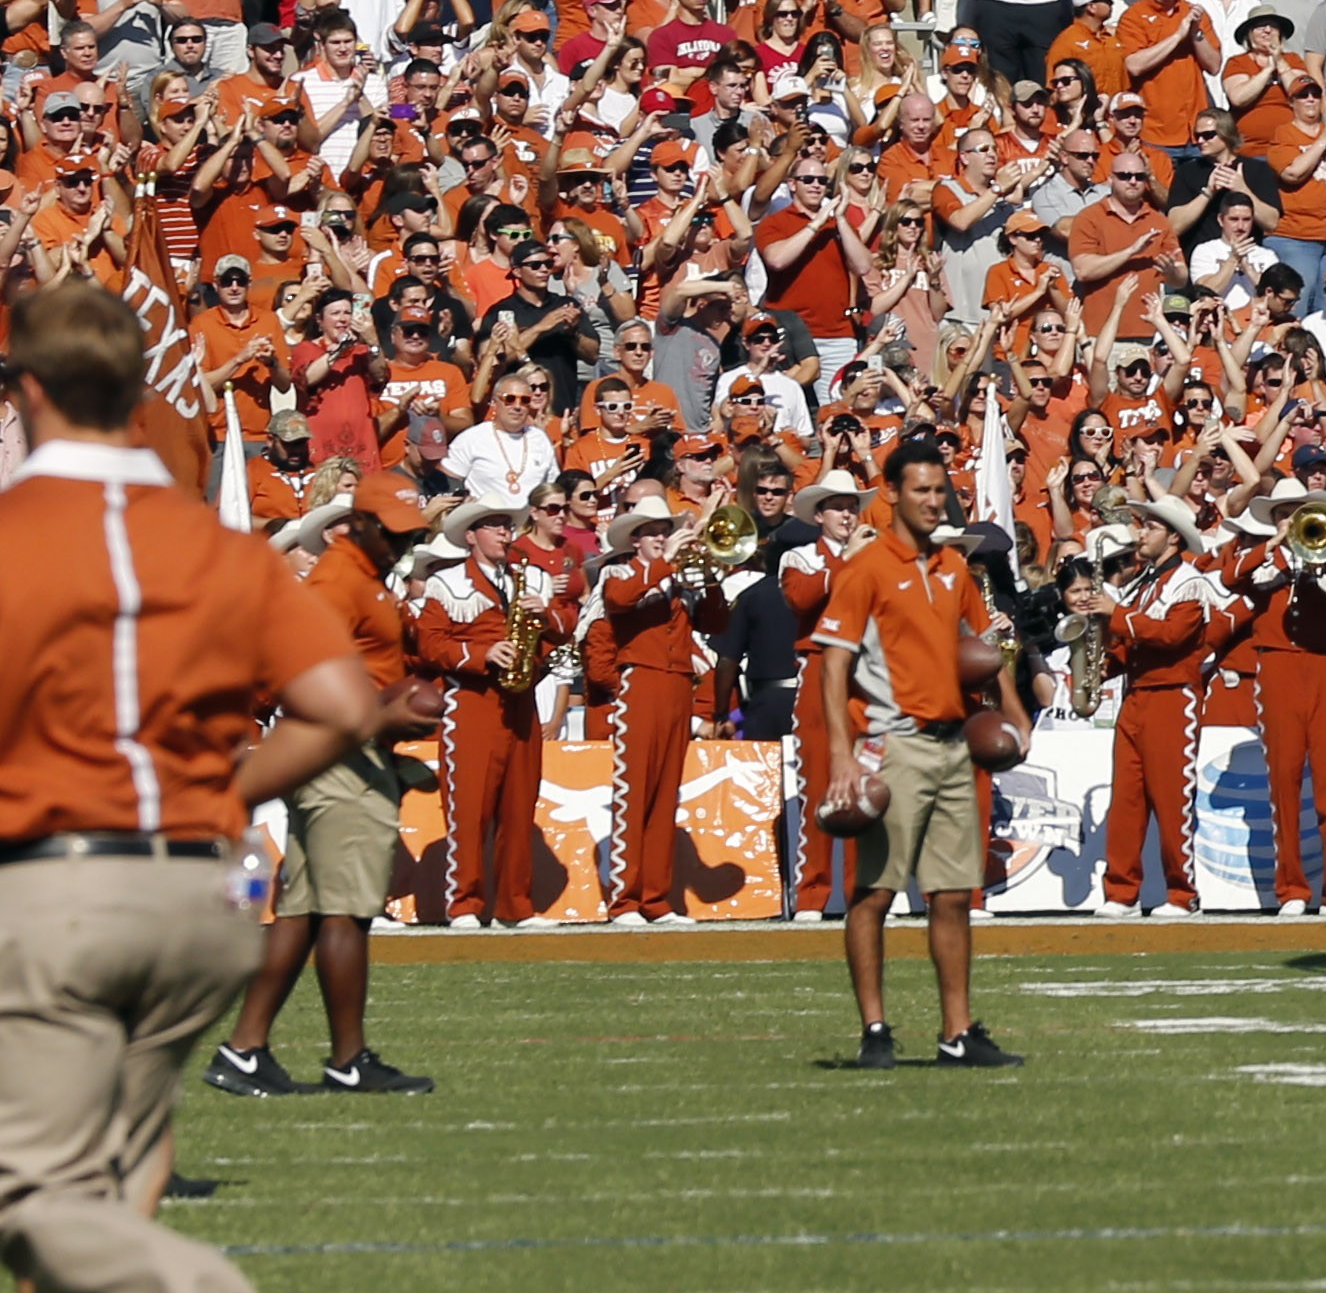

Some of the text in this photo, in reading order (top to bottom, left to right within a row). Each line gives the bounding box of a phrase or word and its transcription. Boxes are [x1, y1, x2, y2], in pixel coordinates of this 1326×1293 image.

[958, 46, 970, 56] T
[788, 79, 800, 88] T
[273, 205, 287, 218] T
[121, 265, 201, 420] TEXAS
[380, 379, 447, 398] TEXAS
